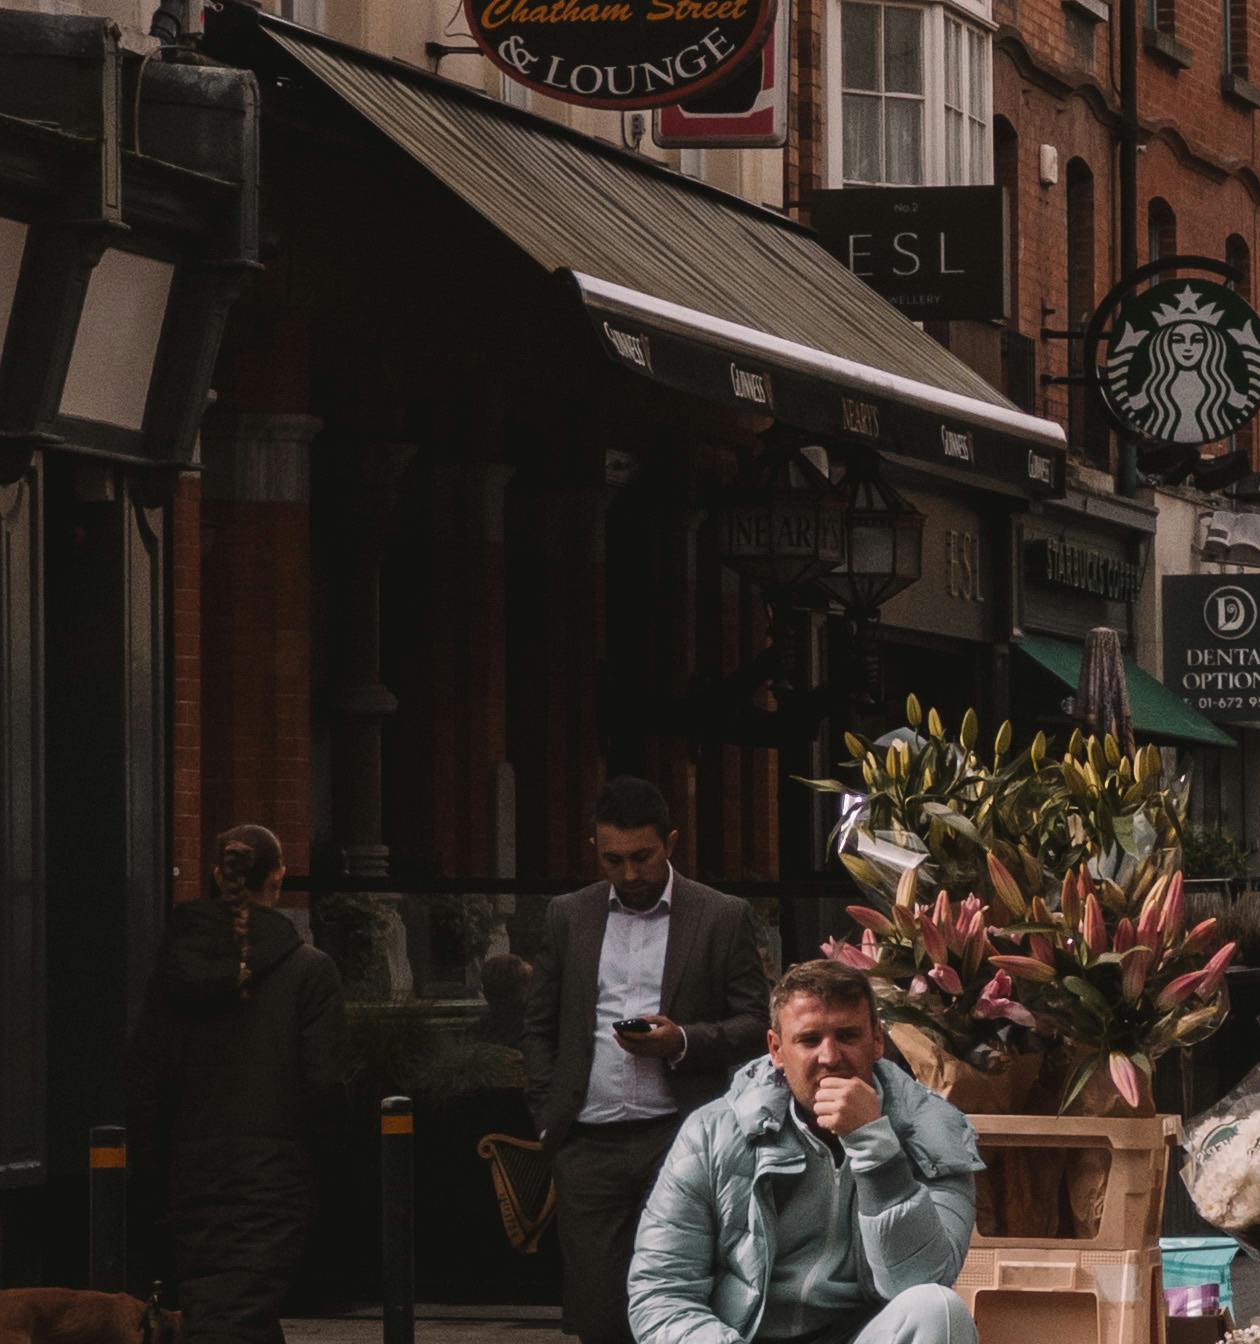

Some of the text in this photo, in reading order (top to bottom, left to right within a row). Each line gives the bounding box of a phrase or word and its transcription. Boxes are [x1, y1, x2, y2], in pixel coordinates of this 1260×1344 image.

[498, 26, 736, 96] & LOUNGE
[849, 231, 966, 276] ESL
[1198, 696, 1244, 710] 01-672
